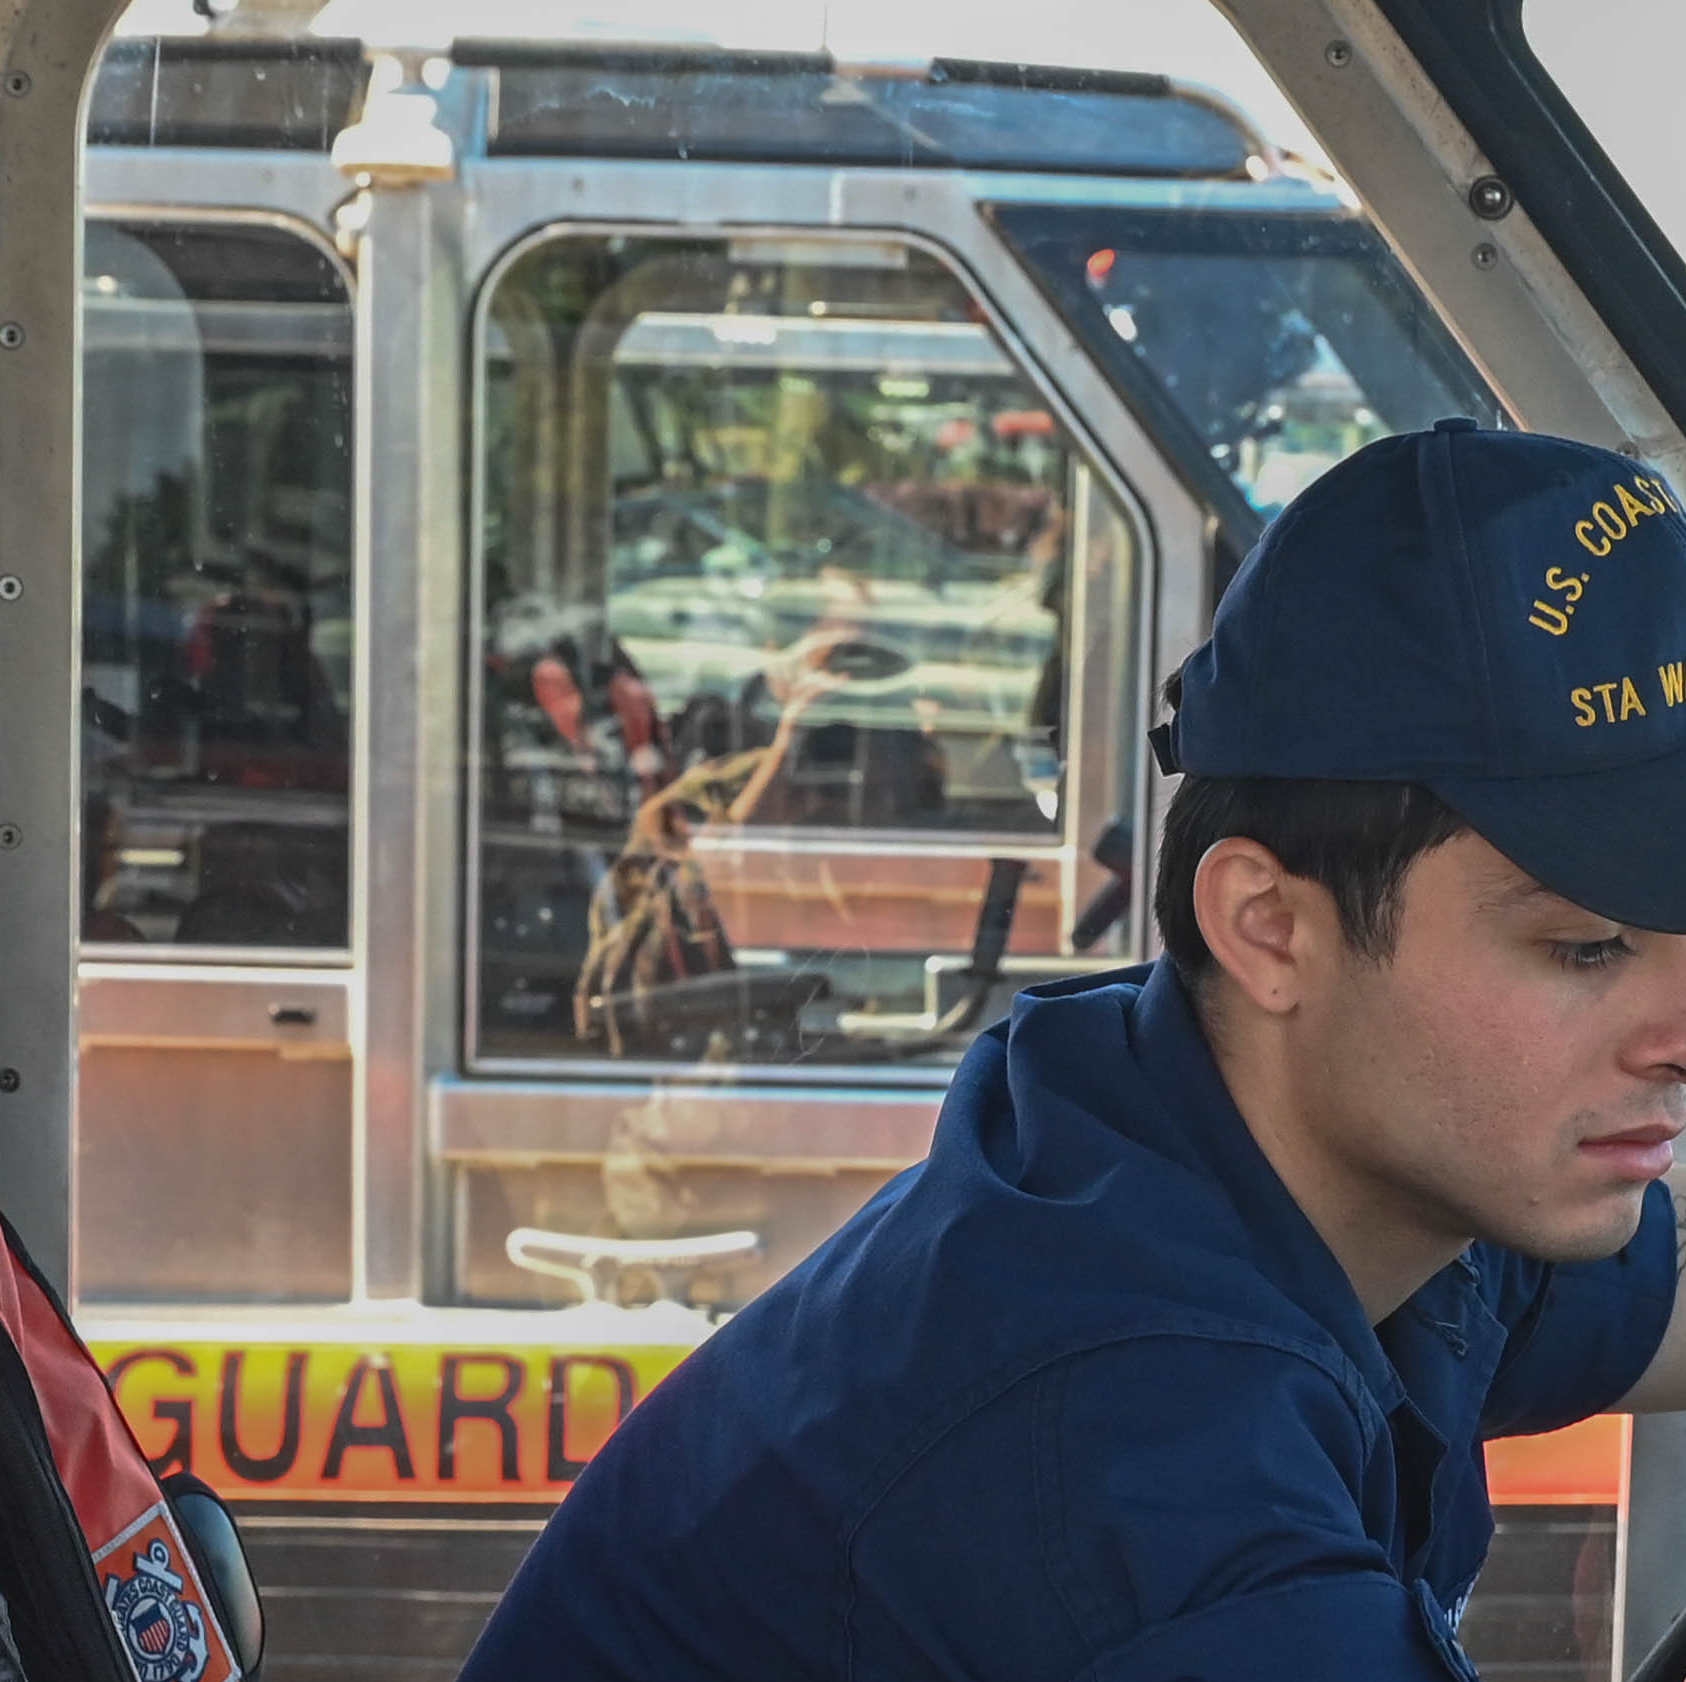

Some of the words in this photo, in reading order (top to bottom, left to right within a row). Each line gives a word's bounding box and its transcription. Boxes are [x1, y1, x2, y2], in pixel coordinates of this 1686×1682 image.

[1528, 566, 1590, 636] U.S.
[1574, 475, 1679, 557] COAST
[1570, 677, 1647, 727] STA
[106, 1348, 639, 1483] GUARD
